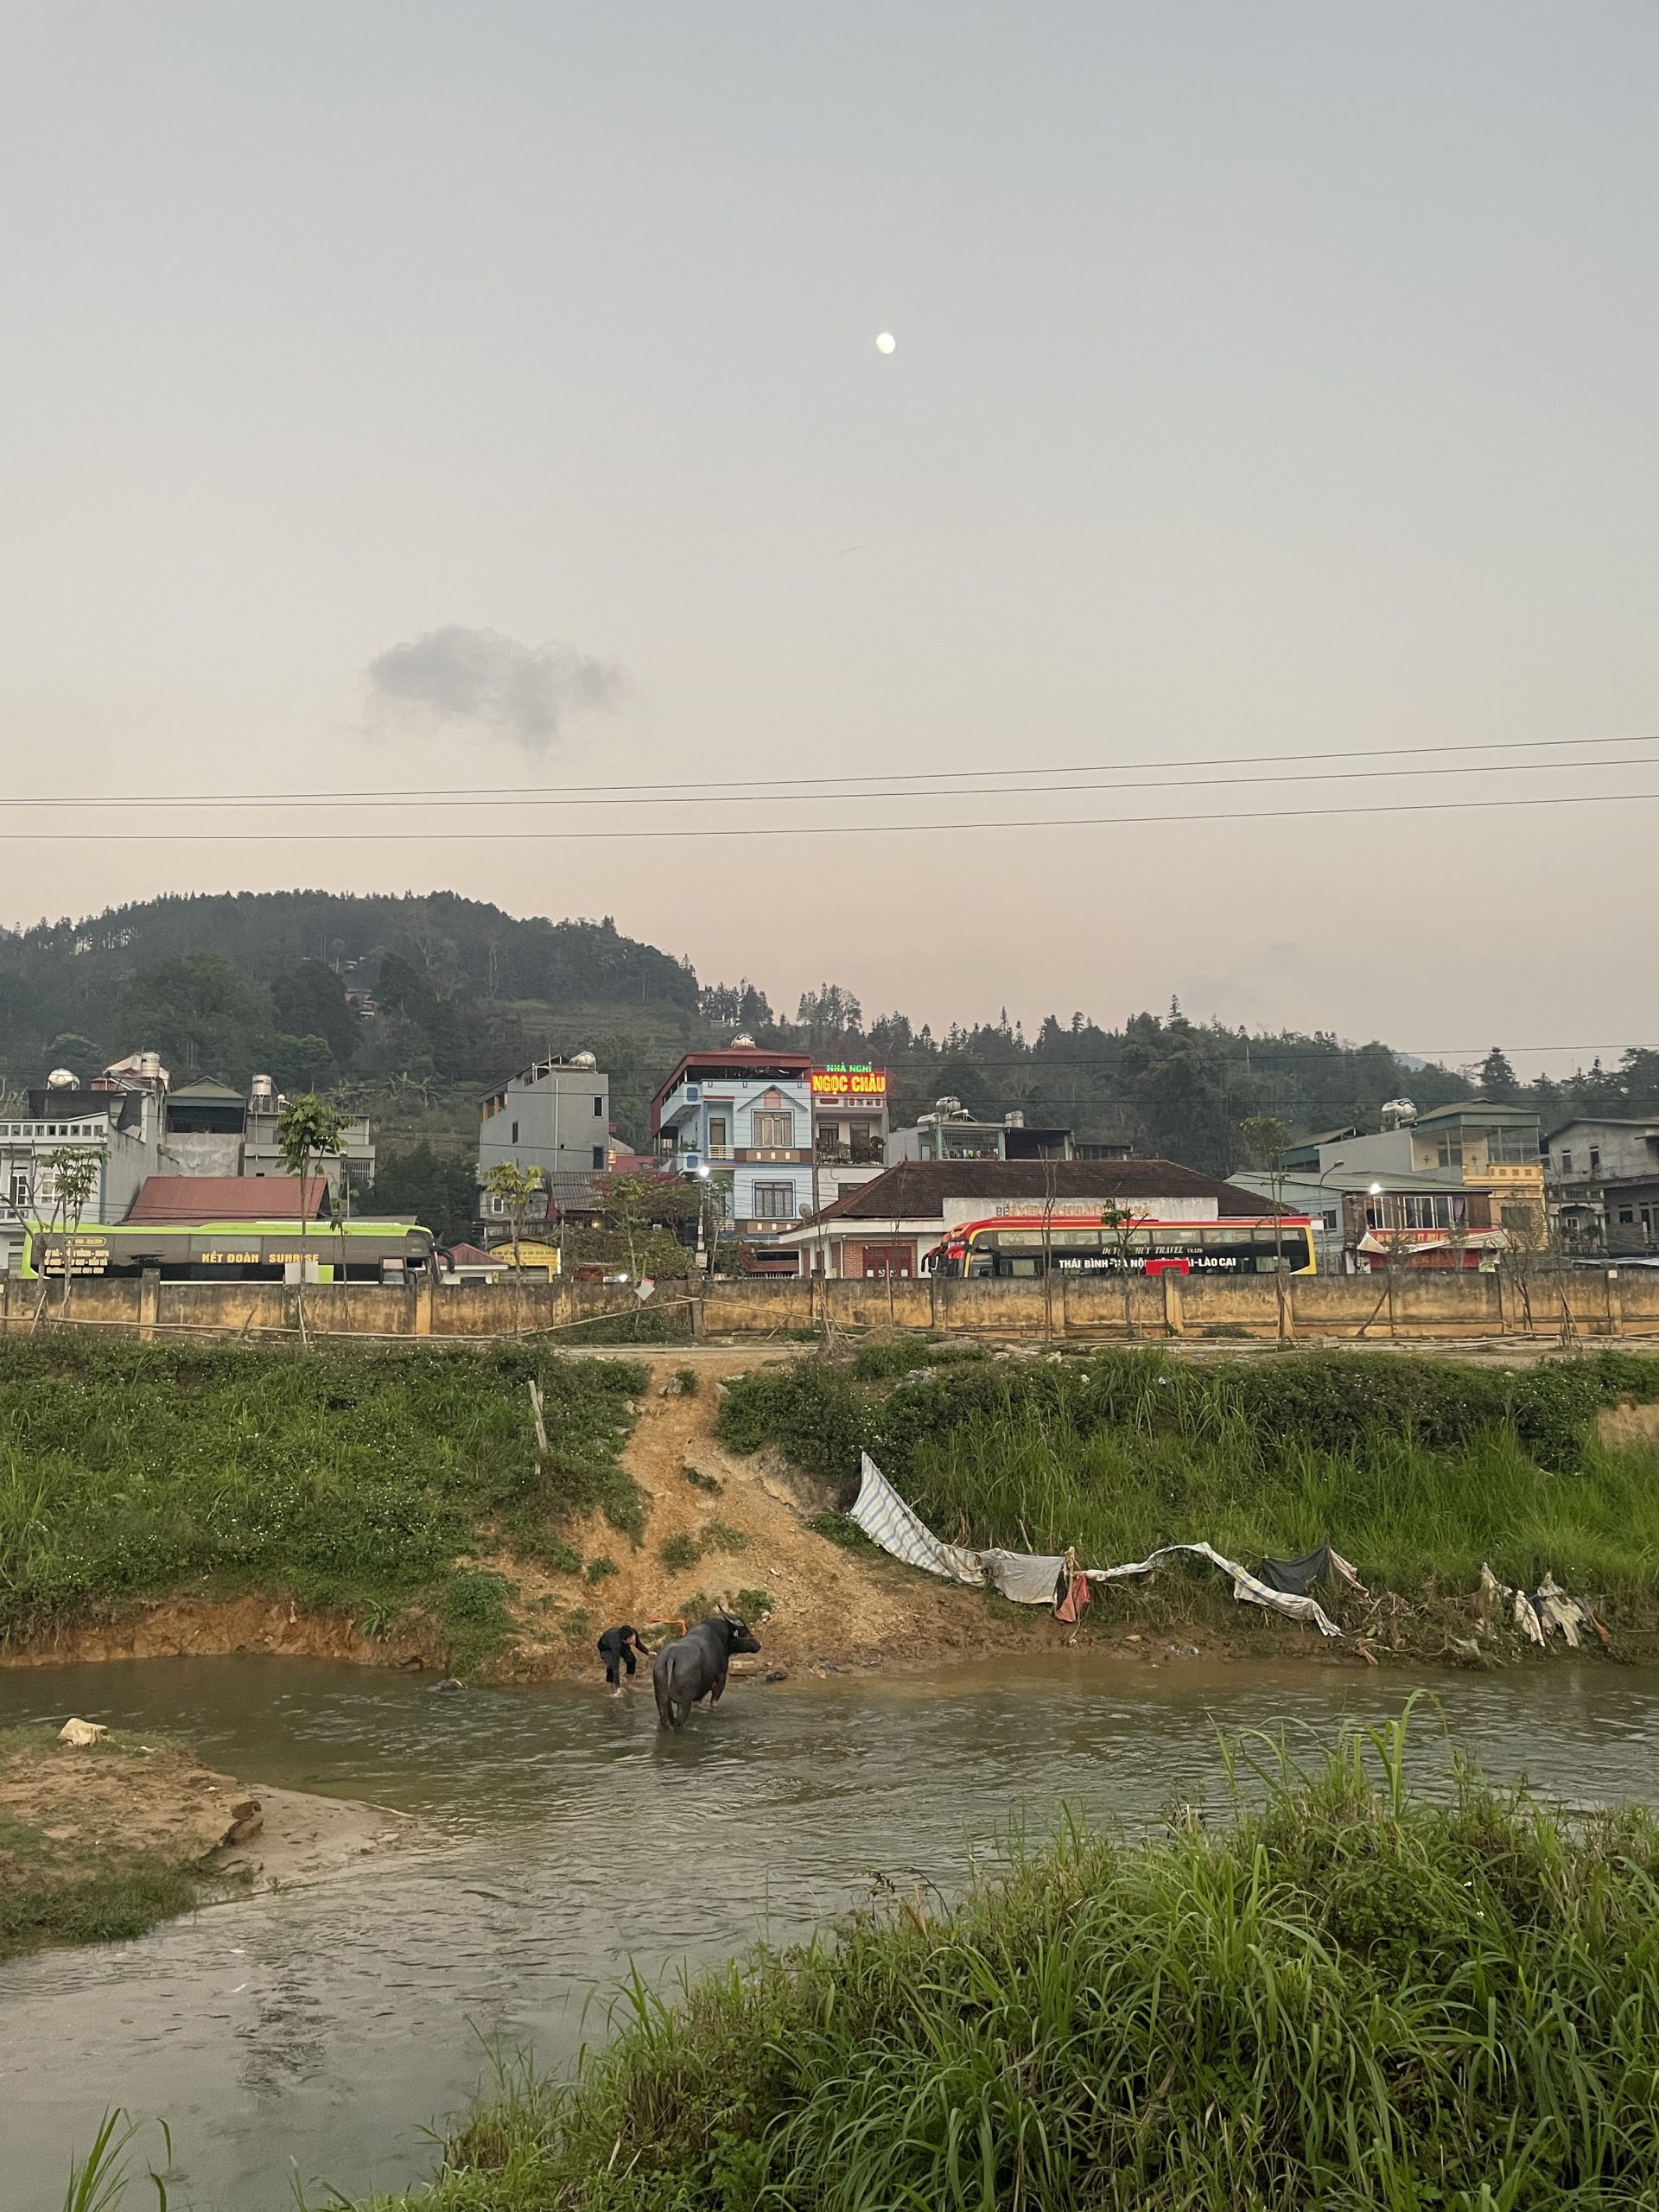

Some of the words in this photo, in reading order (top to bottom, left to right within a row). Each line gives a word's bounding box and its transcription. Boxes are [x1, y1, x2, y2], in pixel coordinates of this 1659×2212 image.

[827, 1061, 846, 1072] NHÀ
[813, 1075, 848, 1095] NGỌC
[851, 1073, 886, 1092] CHÂU
[1058, 1258, 1081, 1268] THÁI
[1218, 1258, 1236, 1267] CAI
